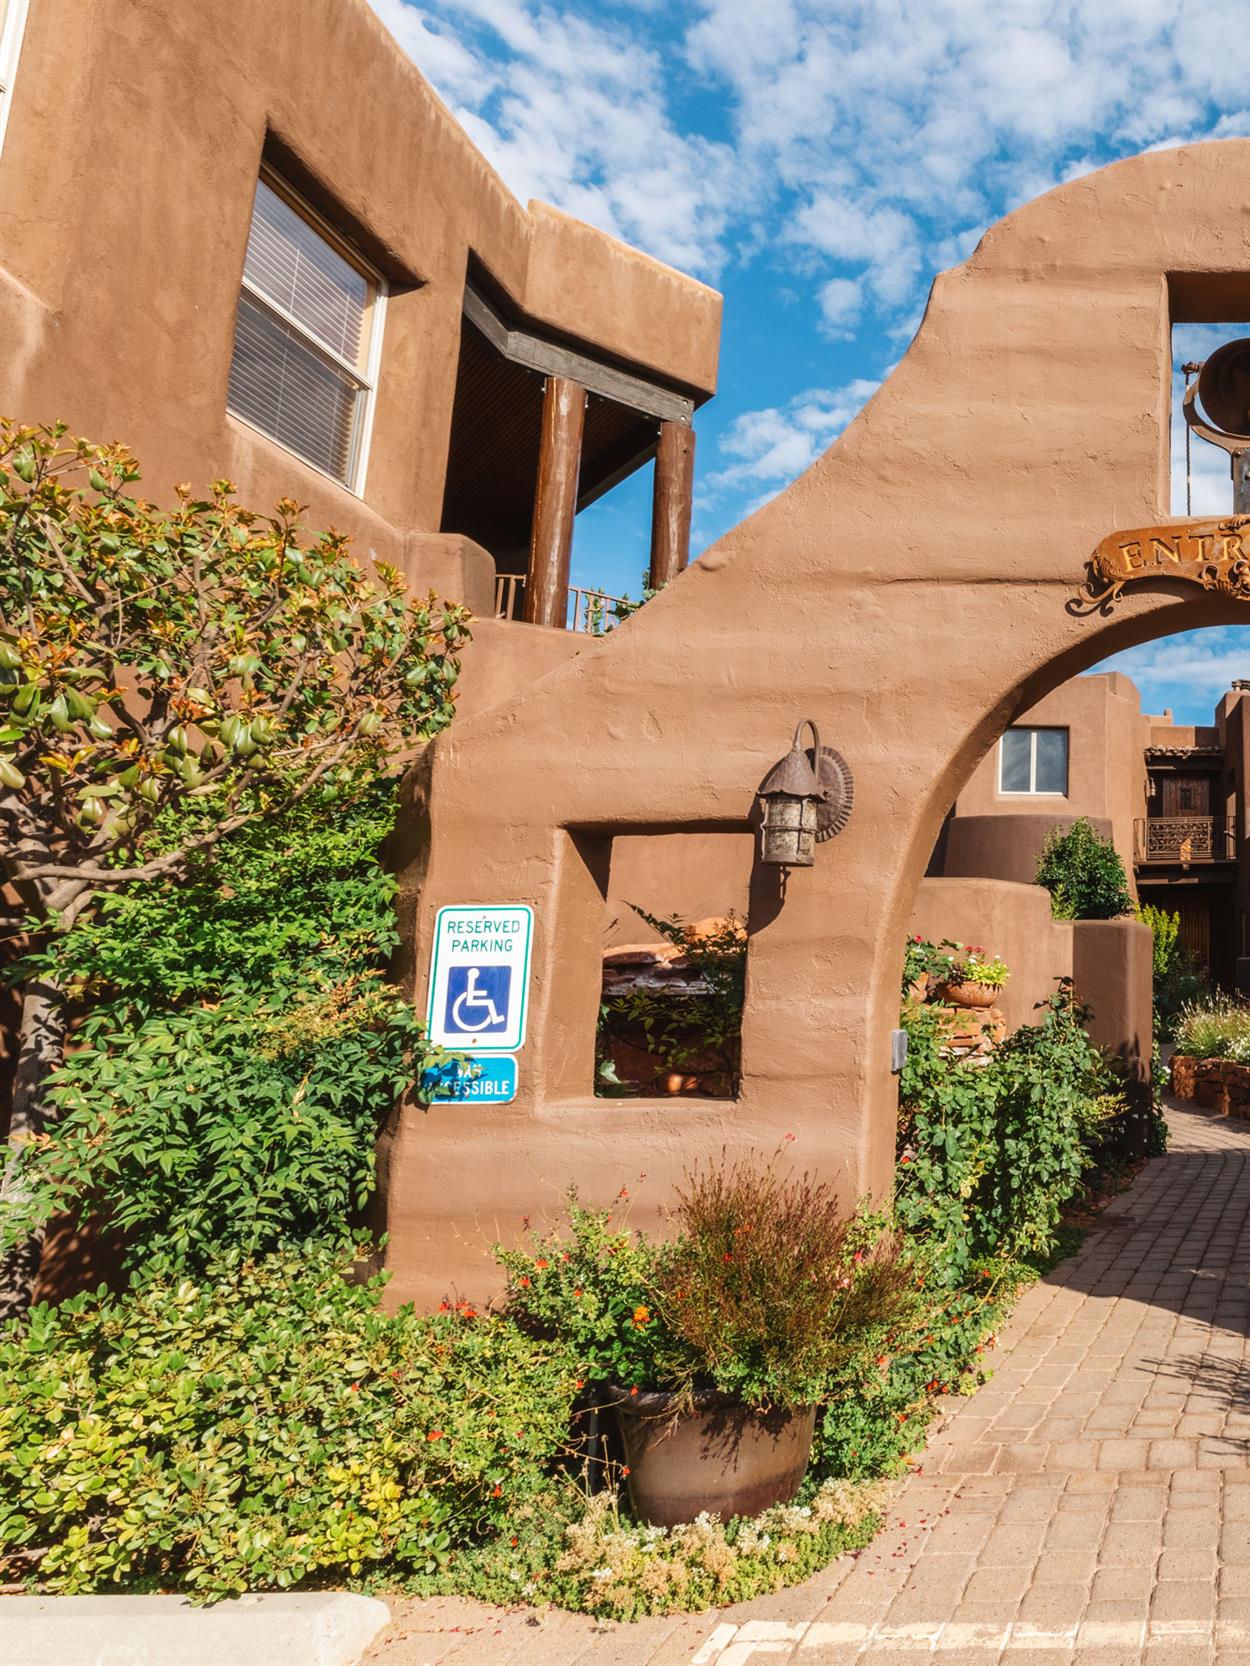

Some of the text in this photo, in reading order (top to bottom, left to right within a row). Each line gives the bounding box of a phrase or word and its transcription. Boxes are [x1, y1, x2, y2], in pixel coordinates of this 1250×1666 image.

[446, 920, 520, 934] RESERVED
[451, 939, 513, 952] PARKING
[423, 1080, 510, 1095] ESSIBLE
